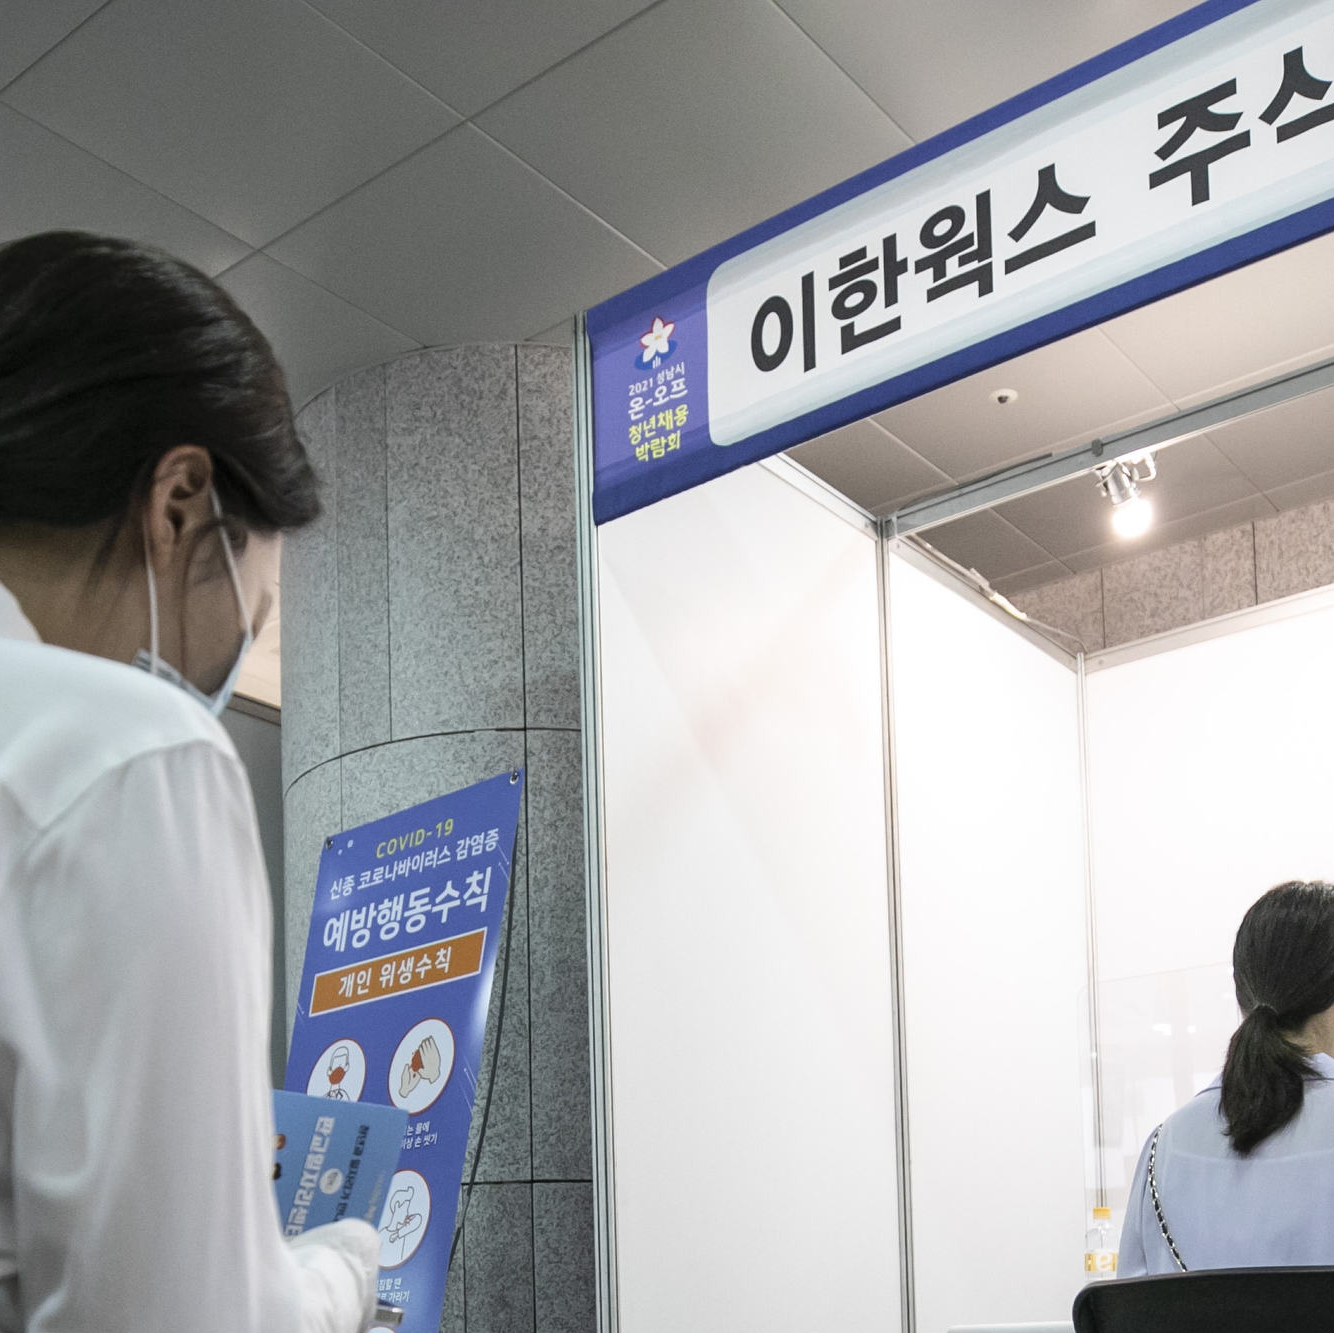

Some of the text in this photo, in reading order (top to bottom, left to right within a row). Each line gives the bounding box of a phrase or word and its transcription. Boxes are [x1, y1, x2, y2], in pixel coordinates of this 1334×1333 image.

[751, 163, 1096, 373] 이한웍스
[628, 361, 685, 396] 2021 성남시
[628, 377, 688, 421] 온-오프
[628, 404, 689, 445] 청년채용
[635, 430, 682, 461] 박람회
[376, 818, 454, 859] COVID-19
[330, 828, 499, 900] 신종 코로나바이러스 감염증
[323, 867, 492, 952] 예방행동수칙
[338, 946, 452, 998] 개인 위생수칙
